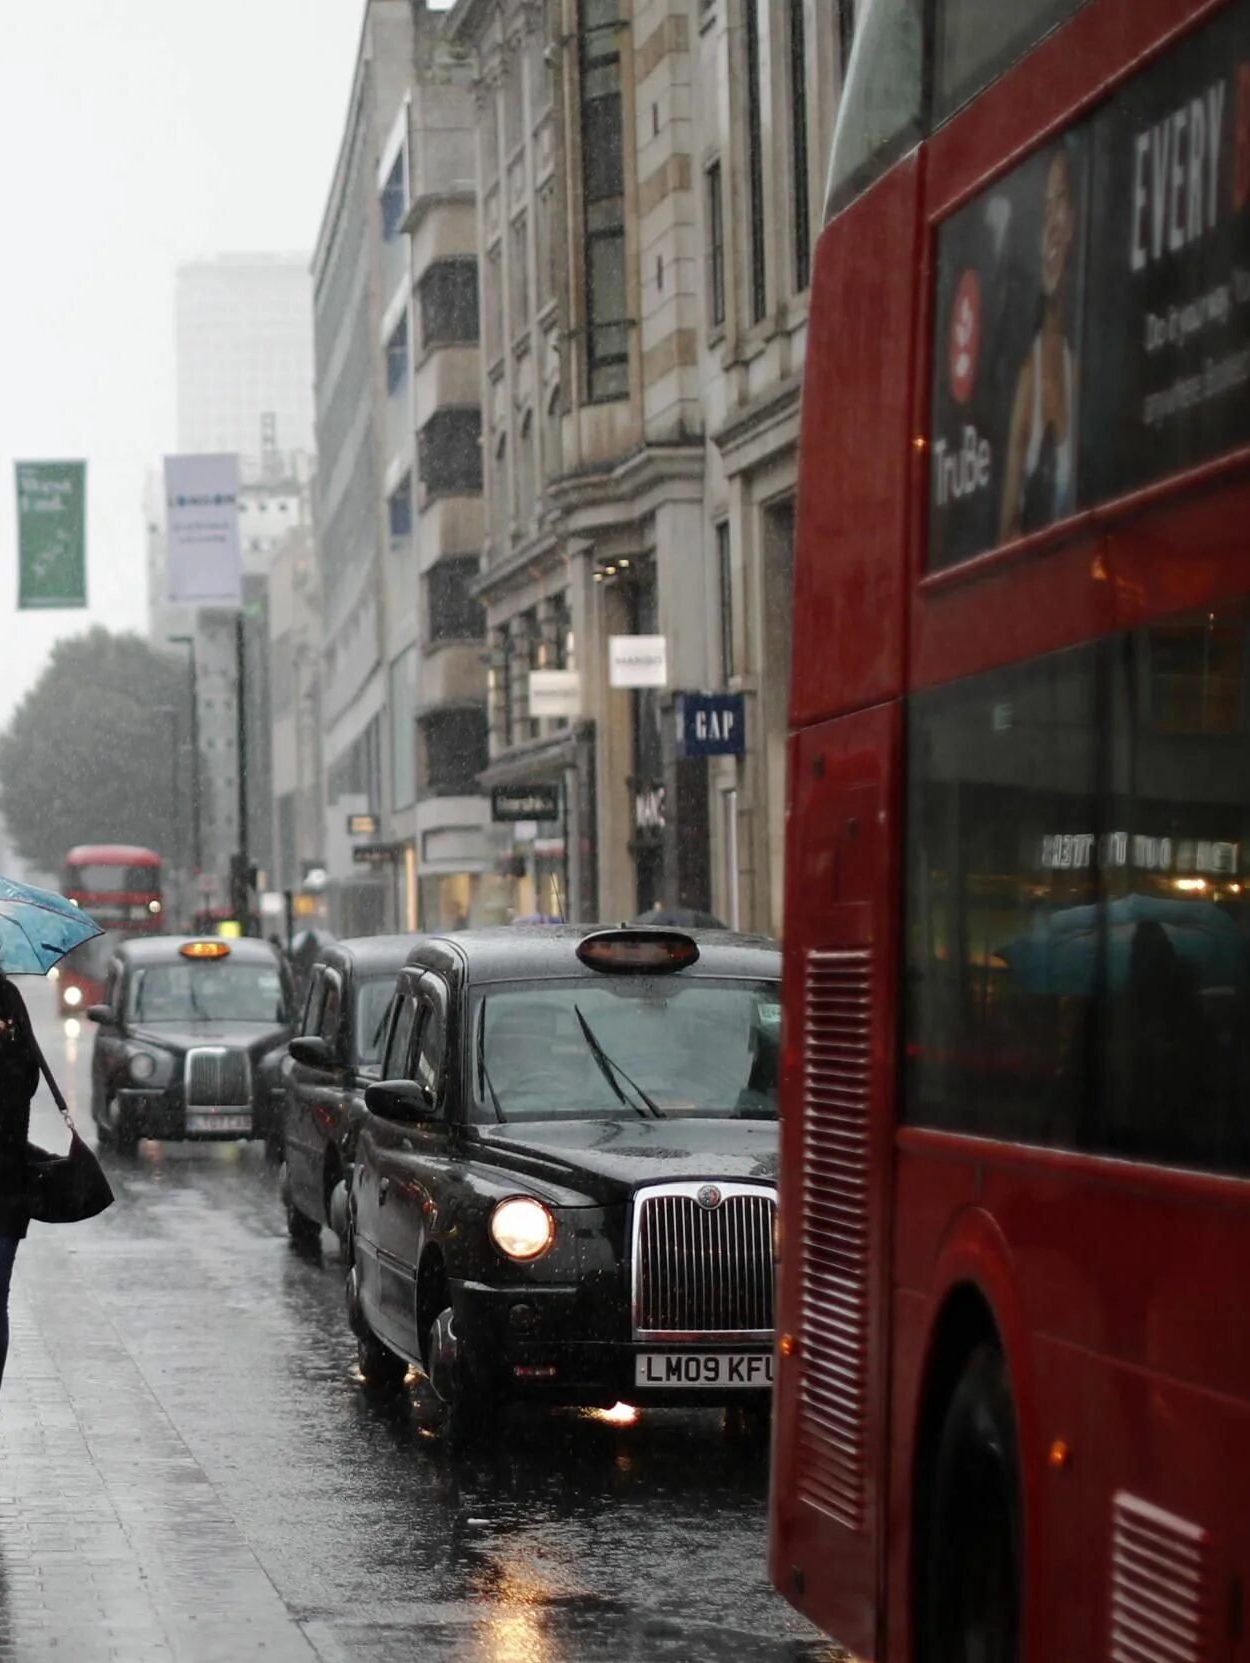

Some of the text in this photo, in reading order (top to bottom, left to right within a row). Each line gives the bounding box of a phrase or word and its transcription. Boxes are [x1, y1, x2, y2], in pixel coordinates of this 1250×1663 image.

[1132, 79, 1226, 273] EVERY
[696, 710, 733, 740] GAP
[646, 1356, 720, 1382] LM09
